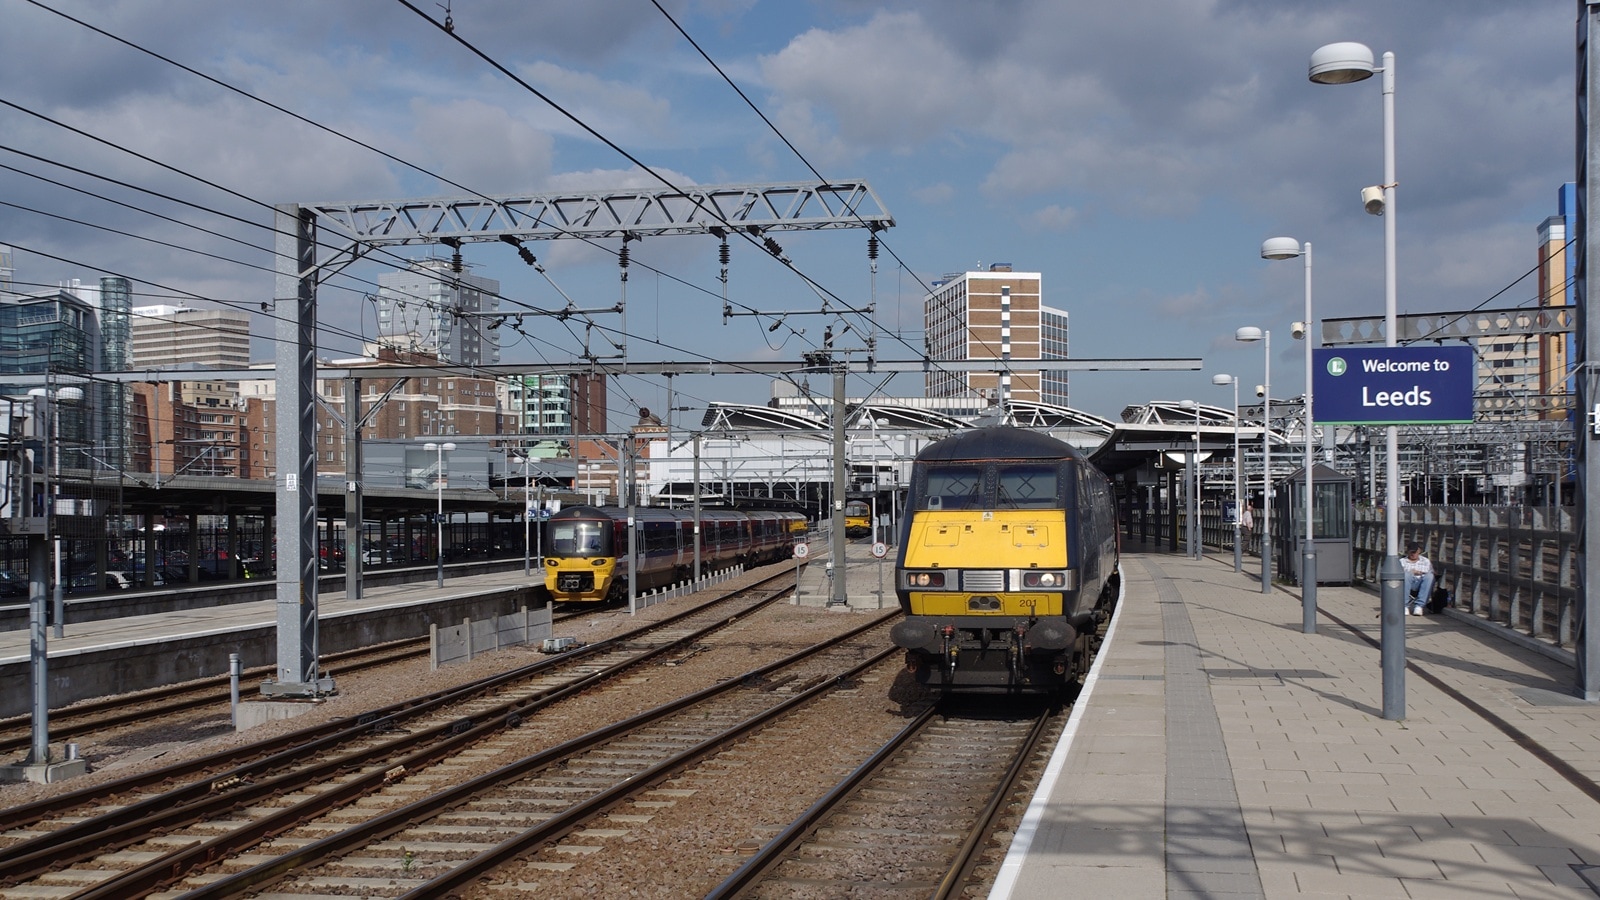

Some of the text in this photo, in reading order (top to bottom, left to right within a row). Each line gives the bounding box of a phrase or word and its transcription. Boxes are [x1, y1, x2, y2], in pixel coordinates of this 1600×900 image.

[1362, 359, 1450, 373] Welcome to
[1362, 386, 1432, 407] Leeds
[797, 546, 806, 554] 15
[875, 546, 884, 554] 15
[1019, 599, 1037, 608] 201
